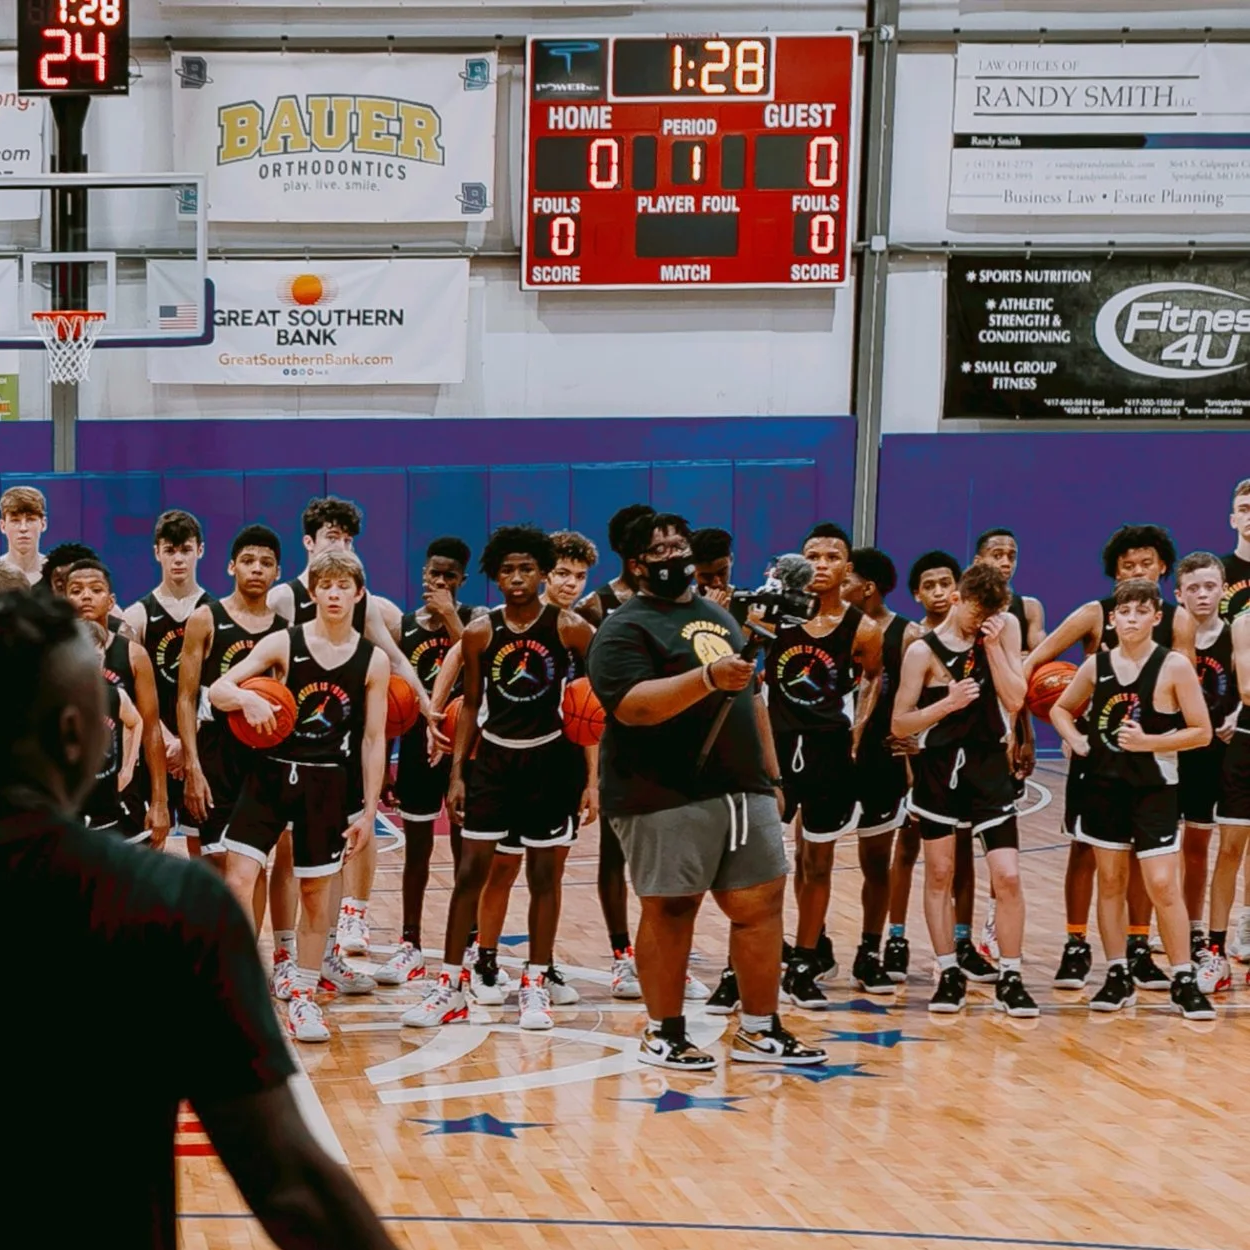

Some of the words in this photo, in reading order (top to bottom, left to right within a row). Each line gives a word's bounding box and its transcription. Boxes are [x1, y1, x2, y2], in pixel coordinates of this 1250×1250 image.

[59, 0, 120, 26] 1:28
[40, 28, 106, 86] 24
[979, 60, 1005, 71] LAW
[1008, 60, 1059, 71] OFFICES
[1062, 60, 1080, 71] OF
[672, 40, 765, 94] 1:28
[974, 86, 1078, 107] RANDY
[1084, 86, 1174, 107] SMITH
[548, 105, 613, 130] HOME
[764, 103, 836, 128] GUEST
[217, 94, 445, 166] BAUER
[663, 118, 717, 136] PERIOD
[971, 136, 996, 148] Randy
[998, 136, 1021, 146] Smith
[259, 160, 407, 180] ORTHODONTICS
[589, 138, 618, 189] 0
[692, 145, 702, 182] 1
[809, 136, 839, 187] 0
[283, 180, 311, 193] play.
[315, 180, 341, 191] live.
[345, 179, 381, 192] smile.
[533, 197, 581, 214] FOULS
[637, 196, 695, 213] PLAYER
[702, 196, 740, 213] FOUL
[792, 195, 840, 212] FOULS
[1004, 189, 1062, 204] Business
[1068, 189, 1096, 204] Law
[1113, 189, 1155, 204] Estate
[1161, 188, 1224, 208] Planning
[551, 216, 576, 256] 0
[811, 214, 835, 255] 0
[532, 265, 581, 283] SCORE
[660, 264, 711, 282] MATCH
[790, 263, 839, 281] SCORE
[979, 270, 1022, 283] SPORTS
[1024, 270, 1092, 283] NUTRITION
[999, 298, 1054, 311] ATHLETIC
[213, 309, 281, 327] GREAT
[288, 309, 404, 327] SOUTHERN
[989, 314, 1050, 327] STRENGTH
[1052, 315, 1062, 327] &
[276, 329, 337, 346] BANK
[978, 330, 1071, 343] CONDITIONING
[219, 352, 393, 367] GreatSouthernBank.com
[1161, 334, 1241, 367] 4U
[974, 362, 1012, 374] SMALL
[1013, 361, 1057, 374] GROUP
[992, 377, 1037, 390] FITNESS
